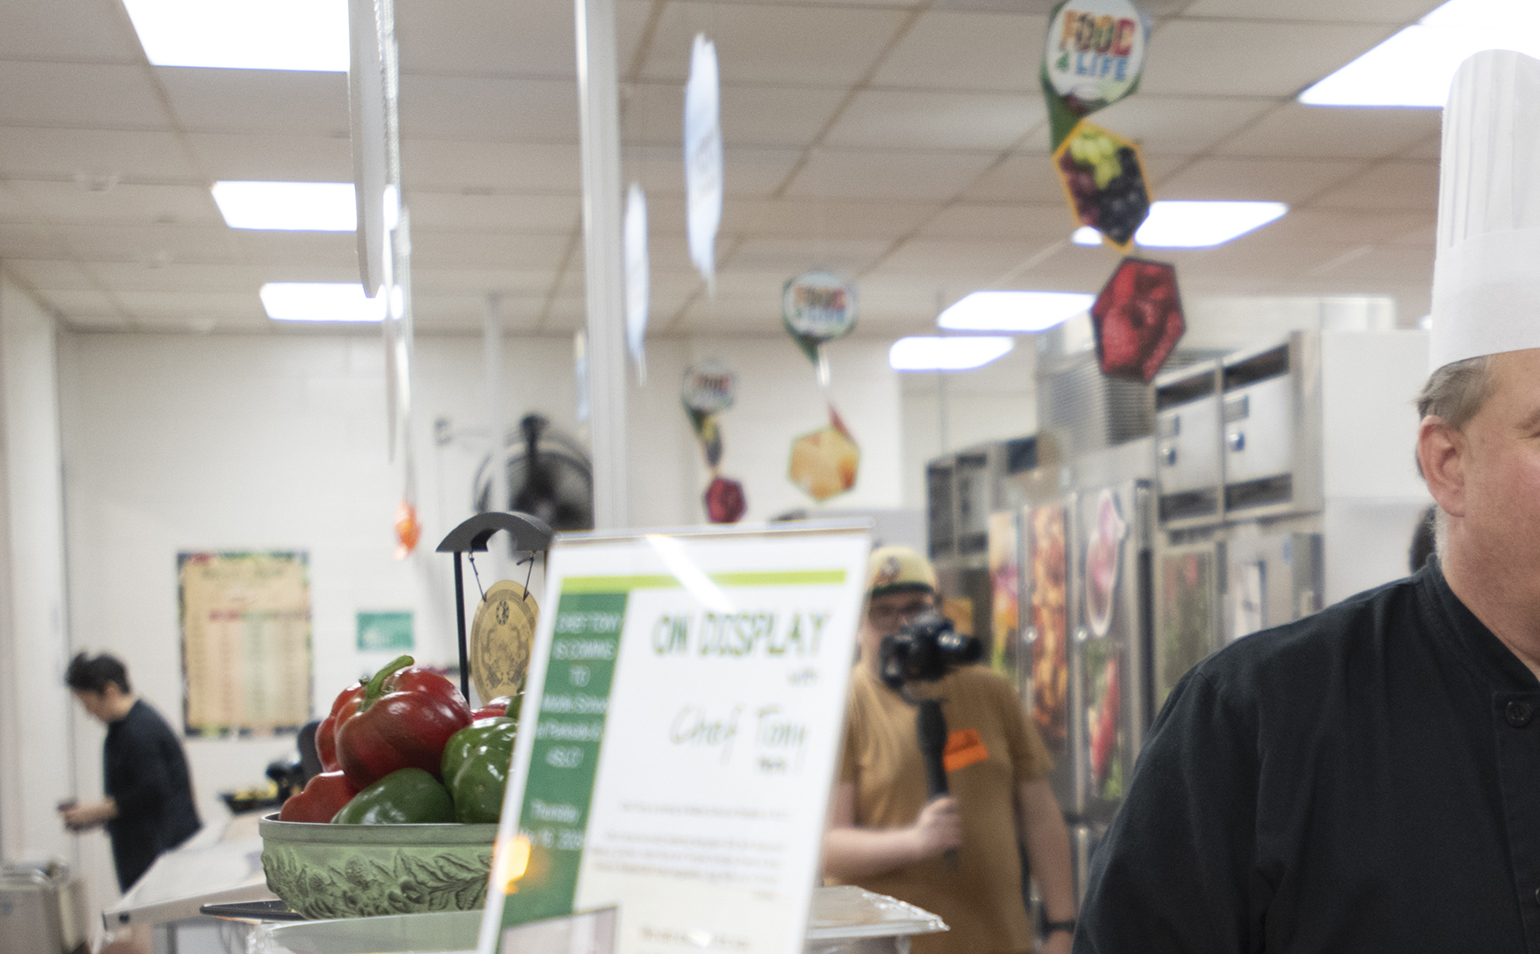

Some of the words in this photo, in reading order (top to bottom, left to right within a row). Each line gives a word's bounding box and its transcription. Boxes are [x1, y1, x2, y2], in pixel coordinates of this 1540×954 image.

[1061, 9, 1135, 57] FOOD
[1075, 52, 1128, 81] LIFE
[653, 613, 690, 656] ON
[700, 611, 830, 656] DISPLAY
[669, 703, 744, 767] Chef
